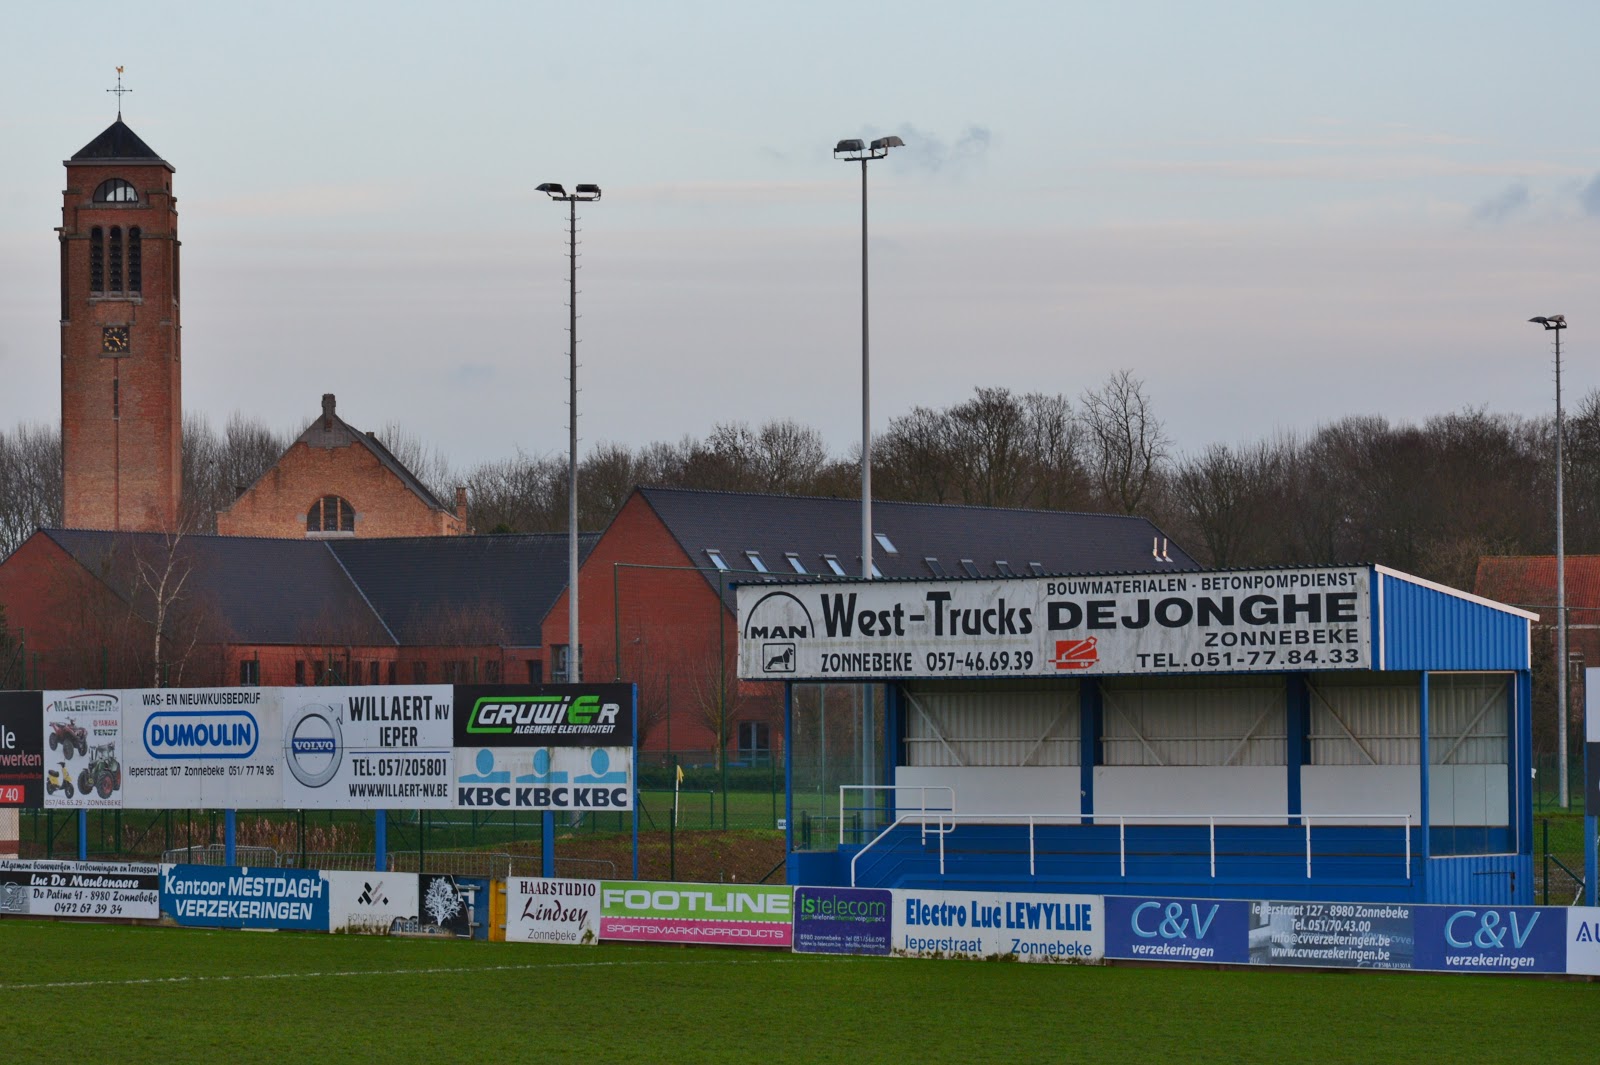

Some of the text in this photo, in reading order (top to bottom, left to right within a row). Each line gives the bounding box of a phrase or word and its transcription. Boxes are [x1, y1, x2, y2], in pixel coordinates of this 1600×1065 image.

[1047, 578, 1187, 596] BOUWMATERIALEN
[1201, 572, 1358, 591] BETONPOMPDIENST
[820, 591, 1033, 638] West-Trucks
[1048, 592, 1358, 631] DEJONGHE
[751, 625, 807, 639] MAN
[1205, 629, 1359, 647] ZONNEBEKE
[821, 651, 1034, 672] ZONNEBEKE 057-46.69.39
[142, 692, 261, 706] WAS- EN NIEUWKUISBEDRIJF
[350, 696, 450, 721] WILLAERT NV
[151, 723, 251, 747] DUMOULIN
[379, 727, 418, 747] IEPER
[514, 724, 616, 734] ALGEMENE ELEKTRICITEIT
[293, 740, 334, 751] VOLVO
[129, 766, 168, 777] Ieperstraat
[170, 767, 181, 776] 107
[184, 766, 224, 776] Zonnebeke
[246, 766, 255, 776] 77
[256, 766, 265, 776] 74
[265, 766, 274, 775] 96
[353, 759, 447, 777] TEL: 057/205801
[6, 788, 19, 801] 40
[350, 783, 448, 798] WWW.WILLAERT-NV.BE
[458, 787, 627, 807] KBC KBC KBC
[1, 861, 31, 872] Algemene
[33, 861, 70, 872] bouwwerken
[76, 862, 119, 874] Verbouwingen
[128, 863, 157, 874] Terrassen
[30, 874, 139, 888] Luc De Meulenaere
[164, 874, 323, 899] Kantoor MESTDAGH
[520, 880, 596, 897] HAARSTUDIO
[33, 888, 44, 899] De
[46, 889, 72, 900] Patine
[74, 890, 83, 900] 41
[90, 890, 110, 901] 8980
[113, 891, 158, 904] Zonnebeke
[603, 889, 790, 914] FOOTLINE
[54, 903, 122, 914] 0472 67 39 34
[175, 899, 313, 921] VERZEKERINGEN
[521, 897, 588, 930] Lindsey
[906, 899, 1092, 932] Electro Luc LEWYLLIE
[1252, 903, 1304, 917] Ieperstraat
[1306, 905, 1323, 916] 127
[1330, 906, 1353, 917] 8980
[1355, 906, 1409, 919] Zonnebeke
[1131, 901, 1219, 940] C&V
[1291, 919, 1371, 932] Tel. 051/70.43.00
[528, 928, 577, 941] Zonnebeke
[607, 924, 784, 939] SPORTSMARKINGPRODUCTS
[800, 933, 814, 941] 8980
[1444, 910, 1541, 949] C&V
[906, 935, 1092, 956] Ieperstraat Zonnebeke
[1271, 932, 1391, 948] info@cvverzekeringen.be
[1132, 943, 1215, 960] verzekeringen
[1271, 947, 1390, 962] www.cvverzekeringen.be
[1446, 954, 1535, 970] verzekeringen
